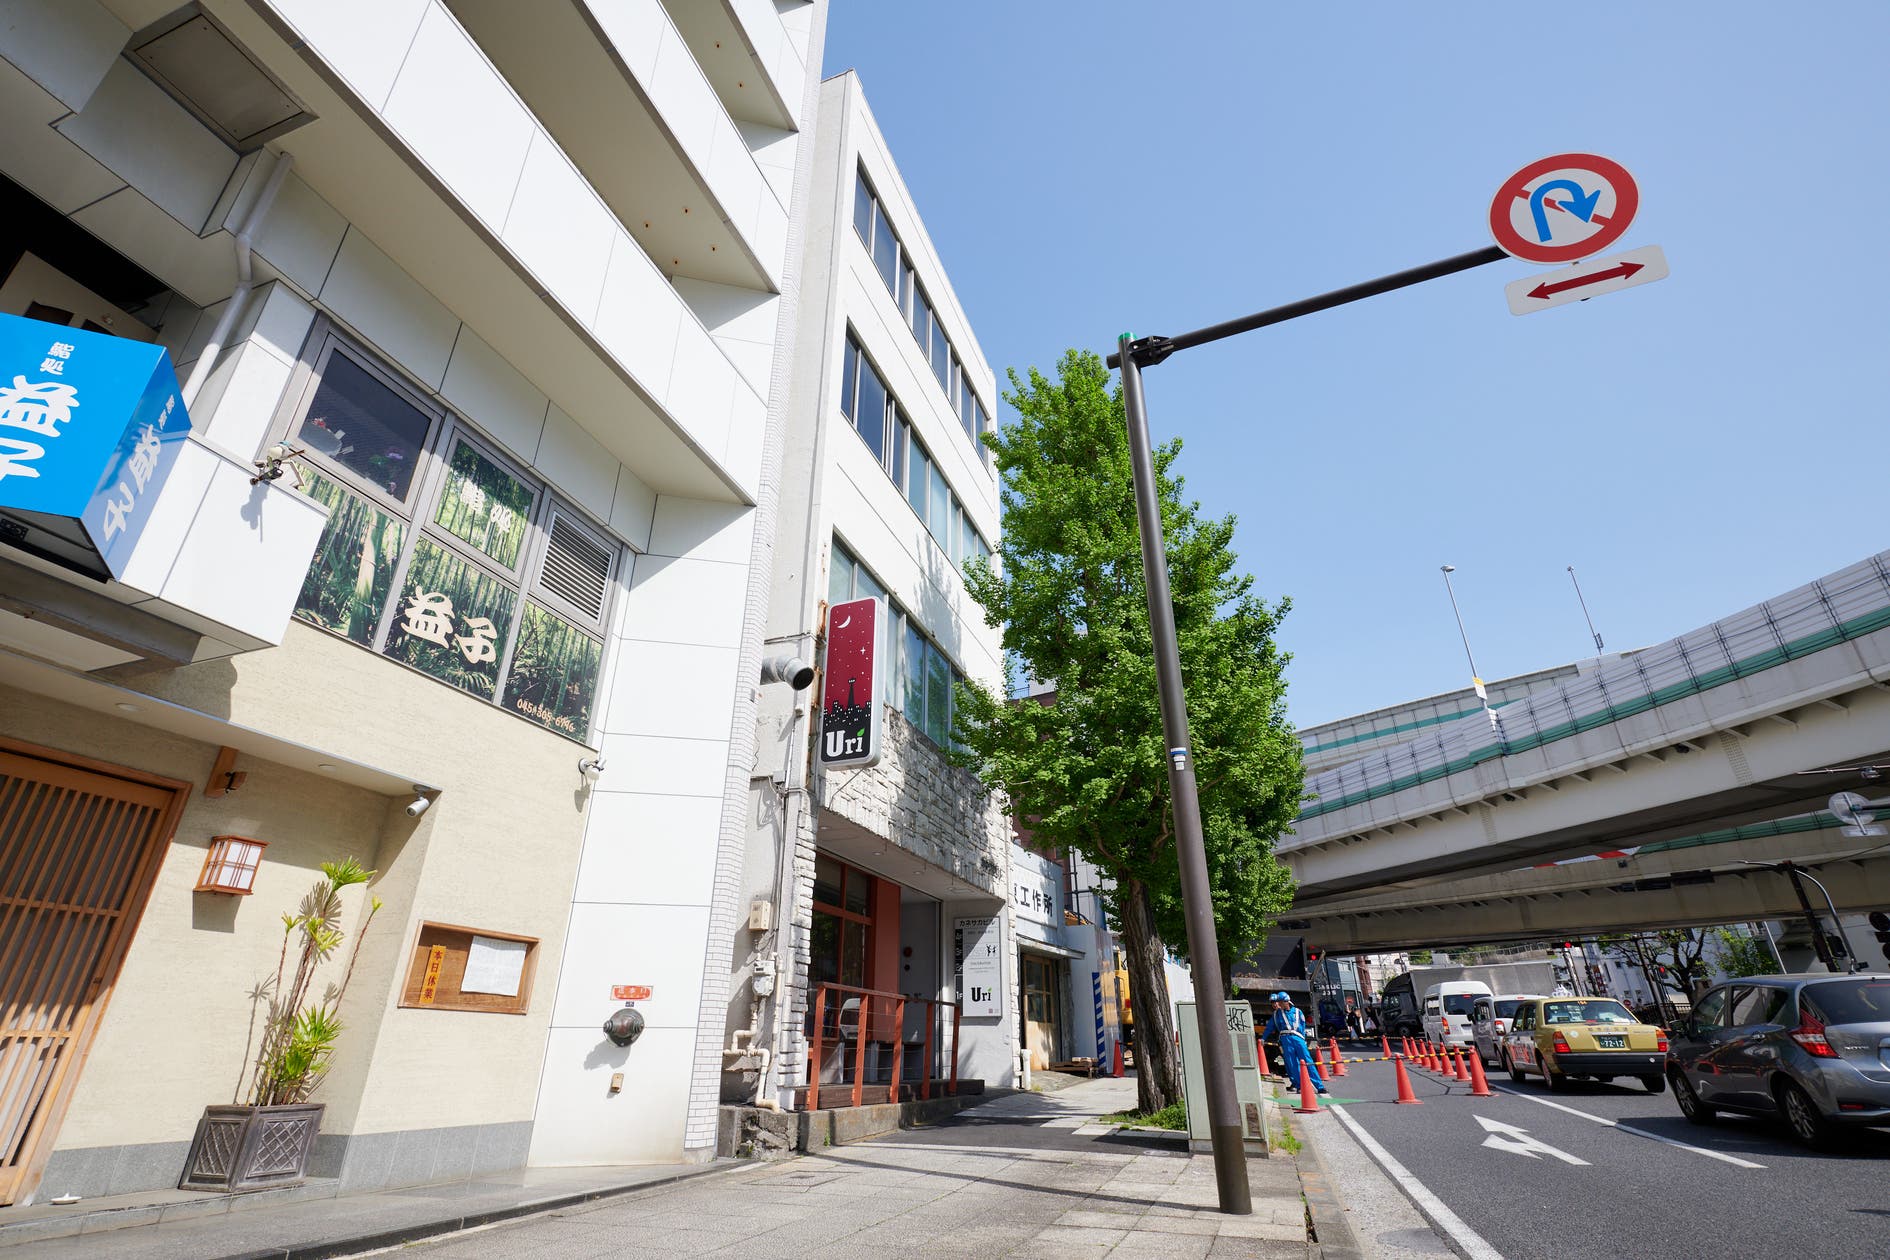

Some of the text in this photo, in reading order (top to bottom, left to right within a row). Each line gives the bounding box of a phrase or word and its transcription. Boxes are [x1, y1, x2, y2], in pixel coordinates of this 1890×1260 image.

[40, 342, 75, 376] 鮨処
[401, 586, 498, 665] 益子
[826, 728, 865, 758] Uri
[971, 987, 992, 1002] Uri
